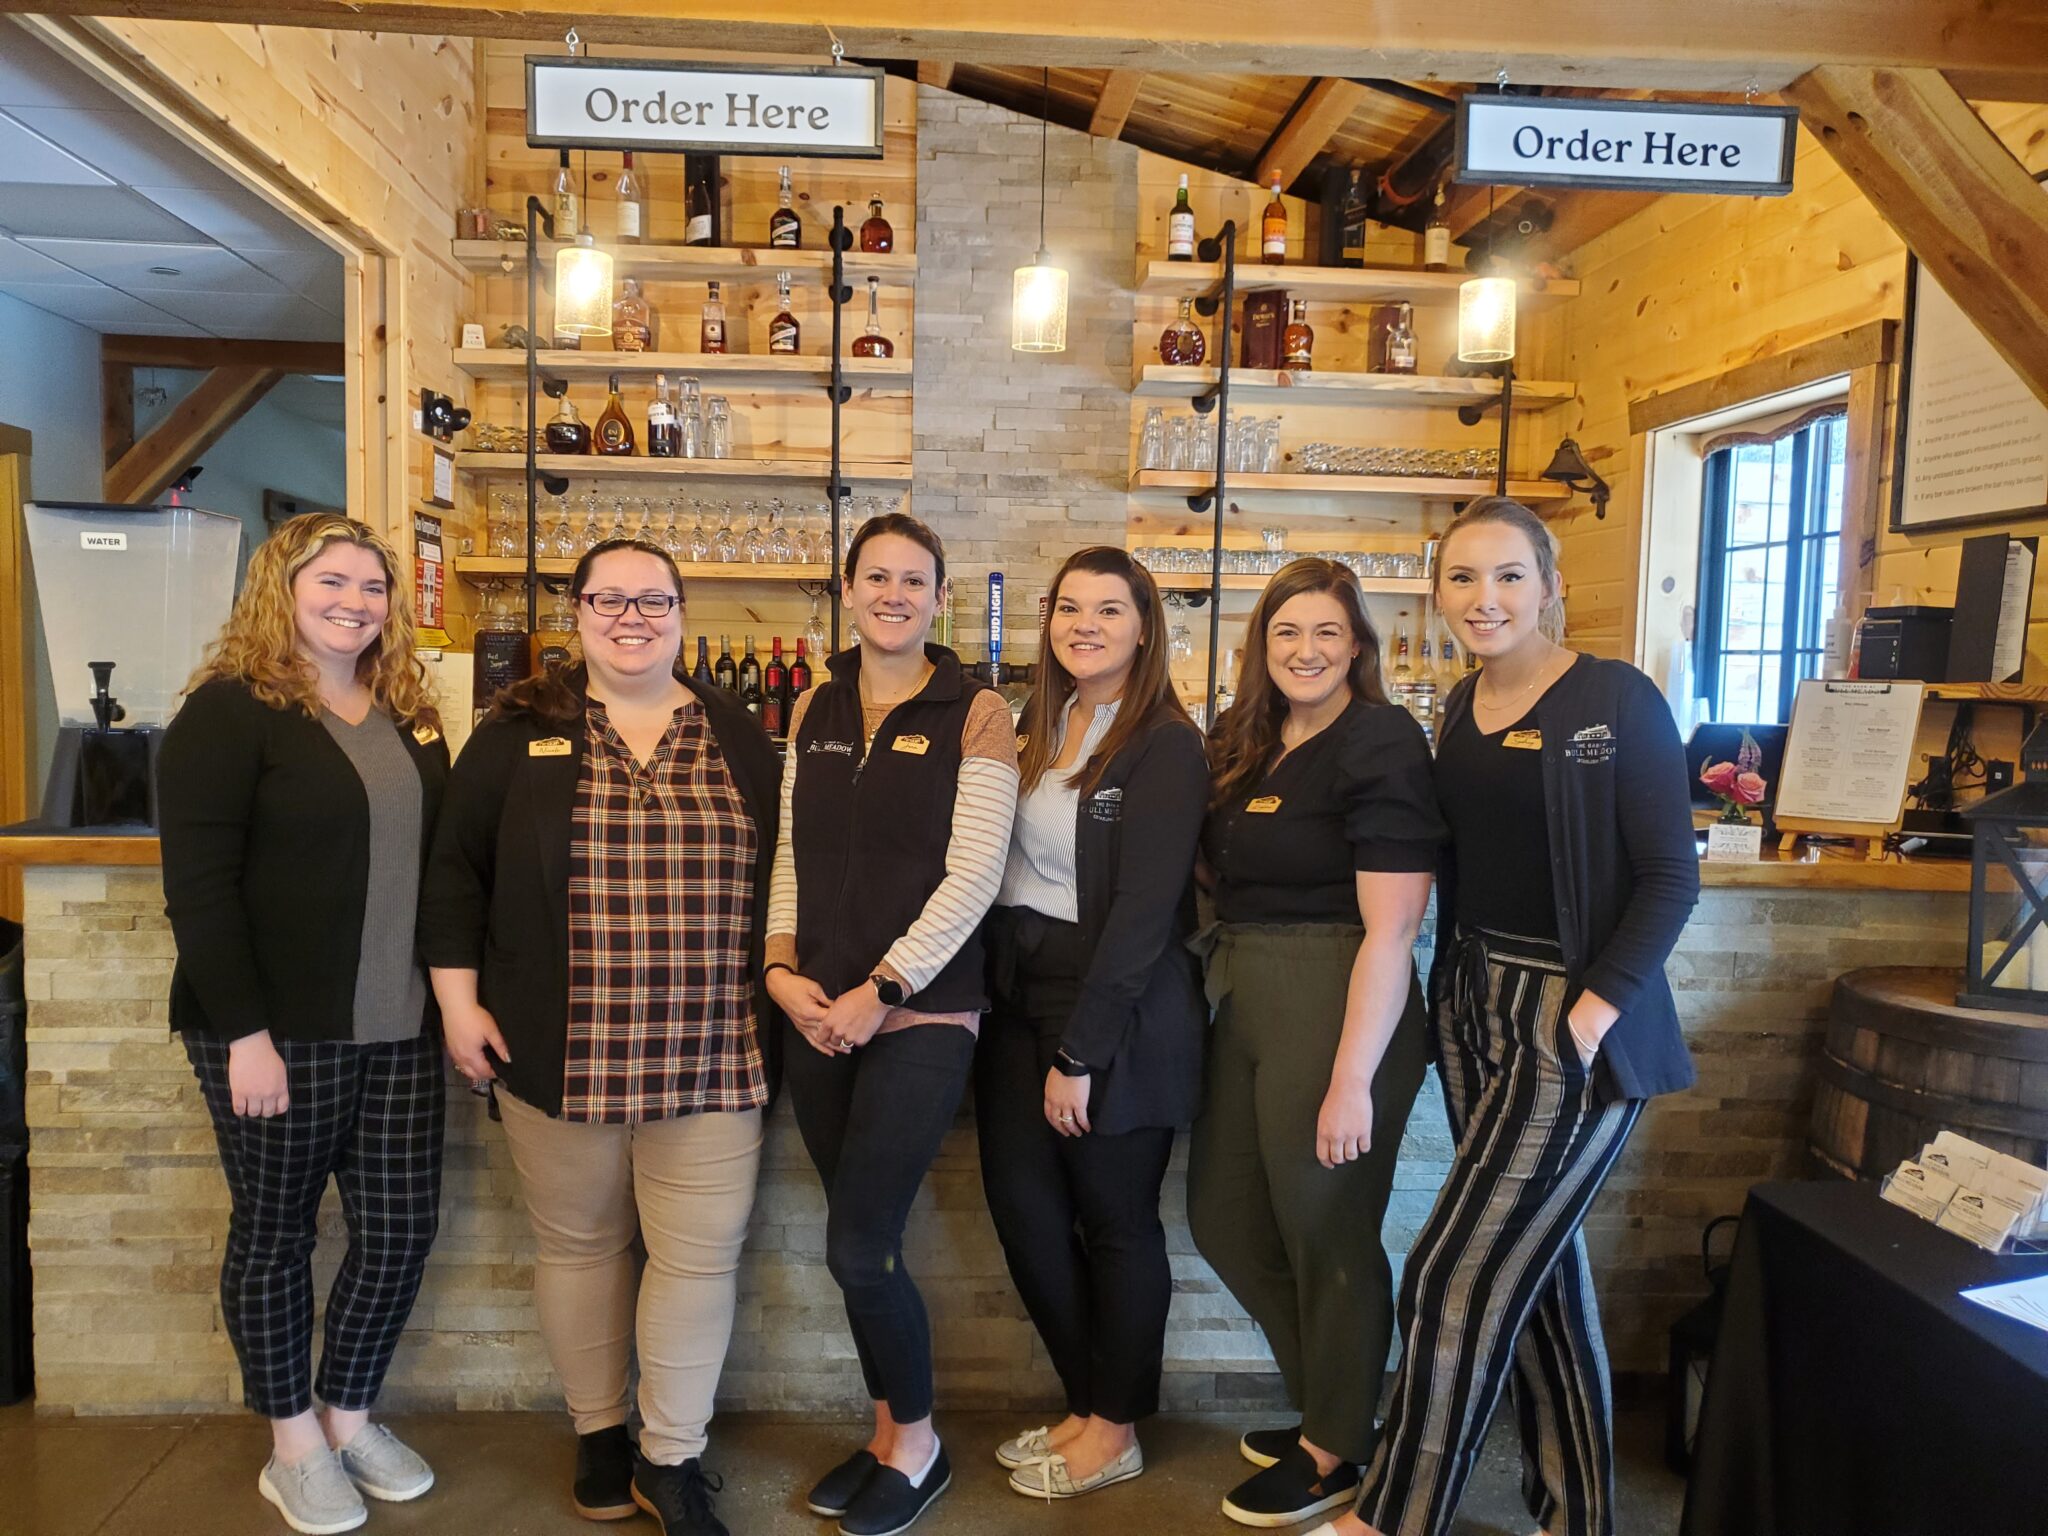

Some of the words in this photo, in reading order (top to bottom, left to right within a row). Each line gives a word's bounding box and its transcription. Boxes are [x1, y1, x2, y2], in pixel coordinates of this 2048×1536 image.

[585, 88, 713, 124] Order
[725, 93, 829, 130] Here
[1513, 125, 1633, 163] Order
[1642, 131, 1741, 167] Here
[87, 537, 121, 546] WATER
[991, 582, 1001, 616] LIGHT
[991, 616, 1001, 641] BUD
